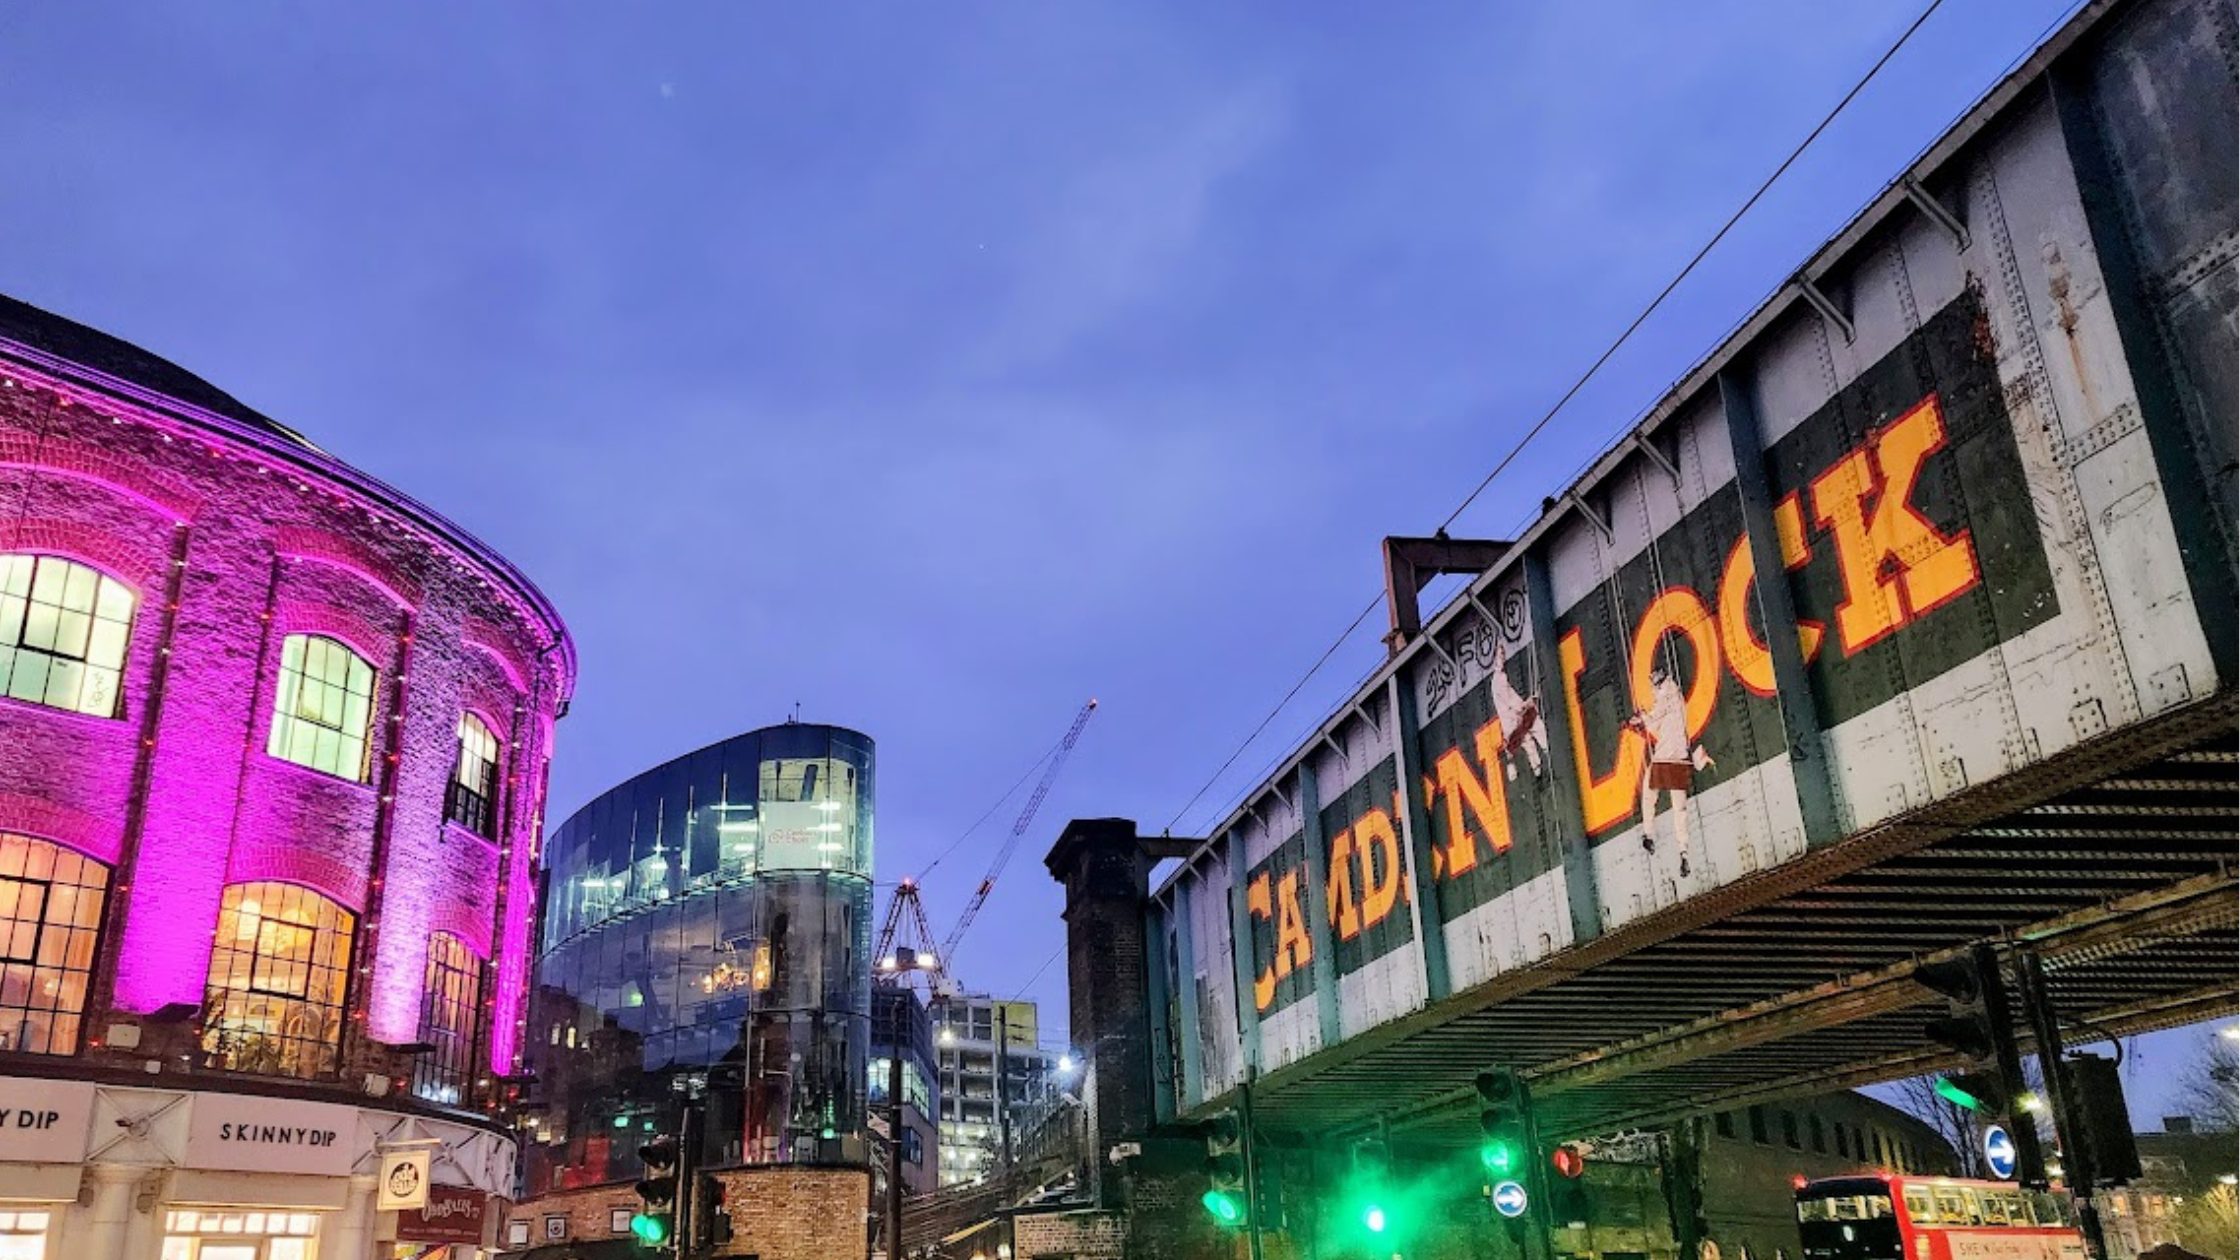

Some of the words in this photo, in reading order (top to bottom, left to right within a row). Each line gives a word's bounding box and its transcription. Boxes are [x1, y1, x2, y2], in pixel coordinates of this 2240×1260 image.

[1248, 714, 1514, 1014] CAMDN
[1558, 391, 1982, 838] LOCK
[18, 1109, 60, 1130] DIP
